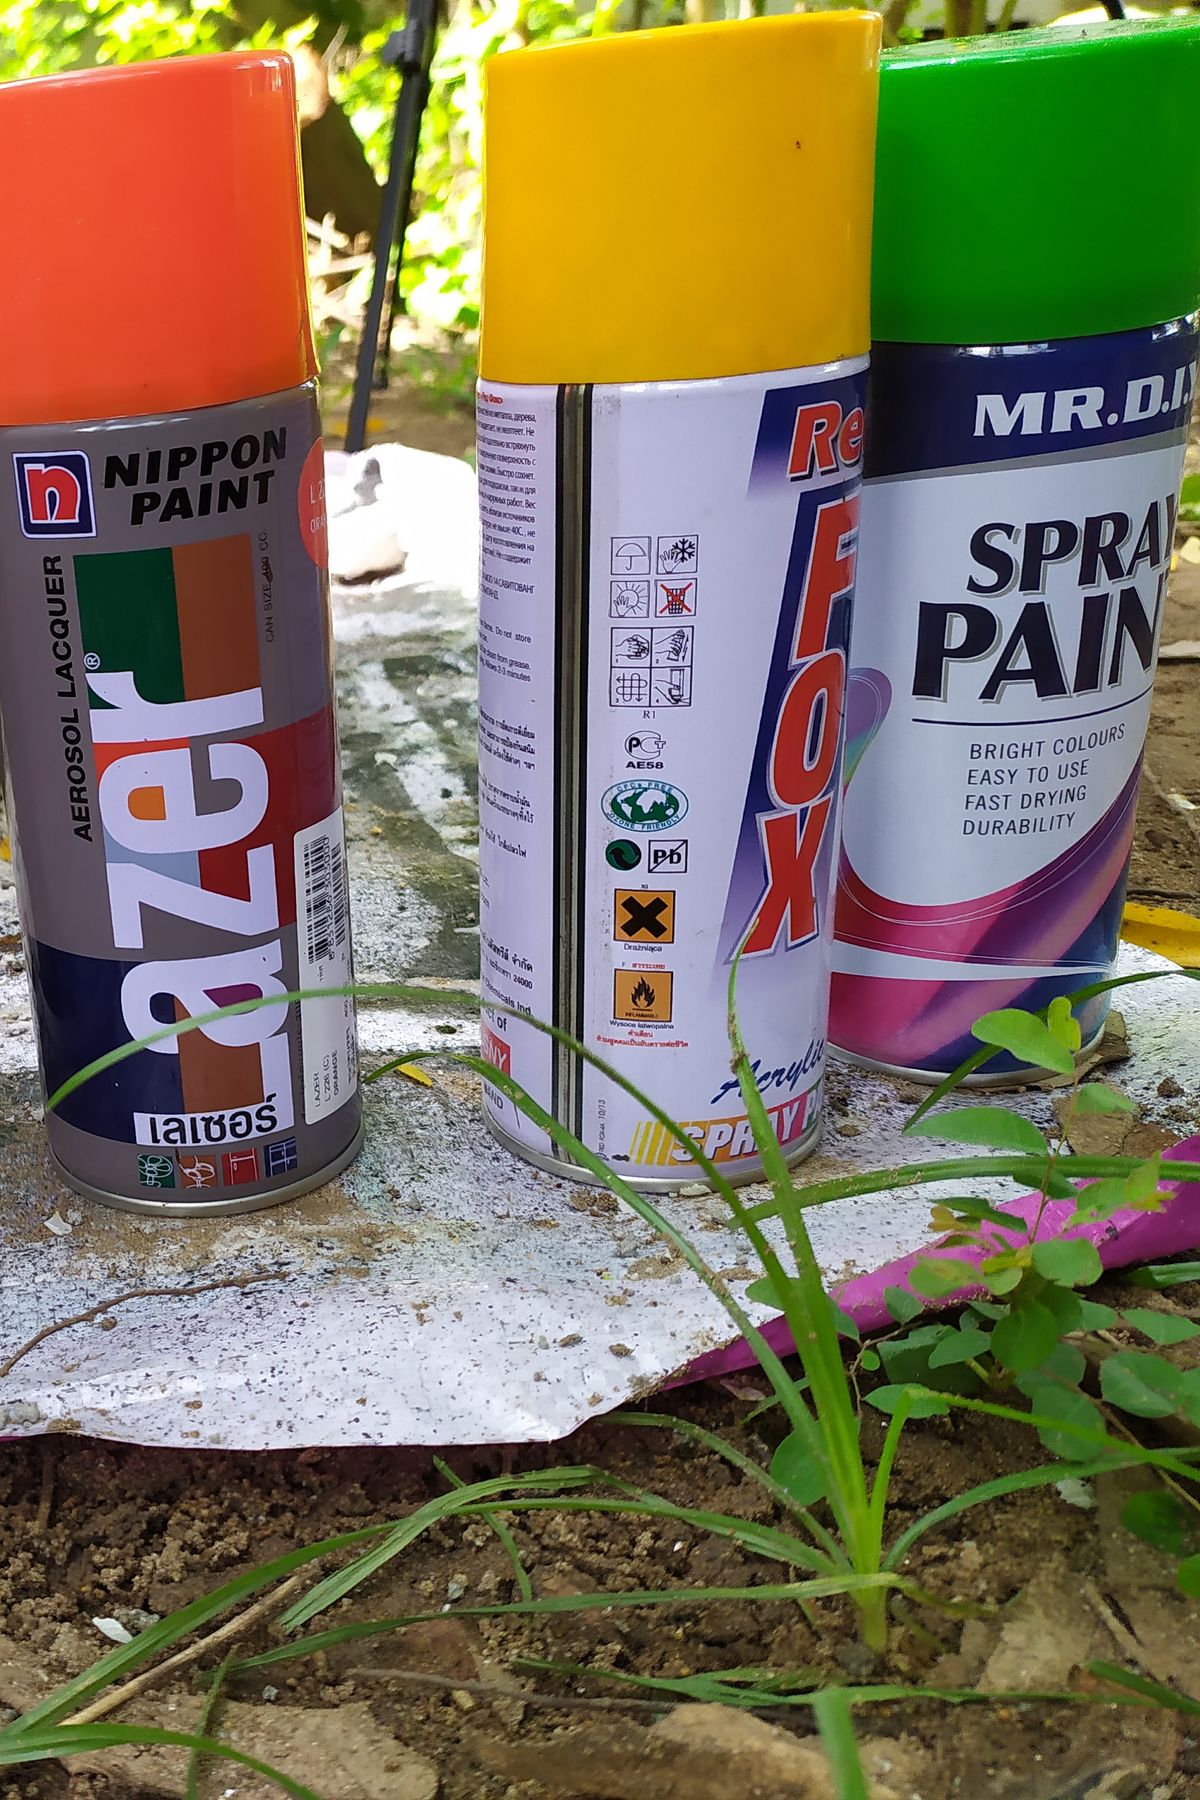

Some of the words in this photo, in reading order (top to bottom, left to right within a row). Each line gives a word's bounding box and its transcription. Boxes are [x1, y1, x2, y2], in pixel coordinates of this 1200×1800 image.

[103, 426, 287, 489] NIPPON
[130, 469, 276, 526] PAINT
[263, 583, 273, 612] SIZE
[43, 555, 77, 699] LACQUER
[265, 616, 275, 643] CAN
[514, 632, 532, 643] store
[507, 669, 531, 682] minutes
[969, 740, 1046, 760] BRIGHT
[1053, 723, 1126, 757] COLOURS
[61, 708, 93, 842] AEROSOL
[967, 768, 1017, 786] EASY
[1026, 765, 1050, 783] TO
[1057, 759, 1089, 779] USE
[647, 781, 674, 794] FREE
[964, 793, 1011, 811] FAST
[1019, 785, 1087, 810] DRYING
[608, 812, 635, 830] OZONE
[641, 814, 681, 831] FRIENDLY
[962, 811, 1076, 836] DURABILITY
[653, 848, 682, 865] Pb
[513, 972, 533, 990] 24000
[496, 1016, 508, 1032] of
[331, 1049, 339, 1096] ORANGE
[149, 1092, 278, 1144] เลเซอร์
